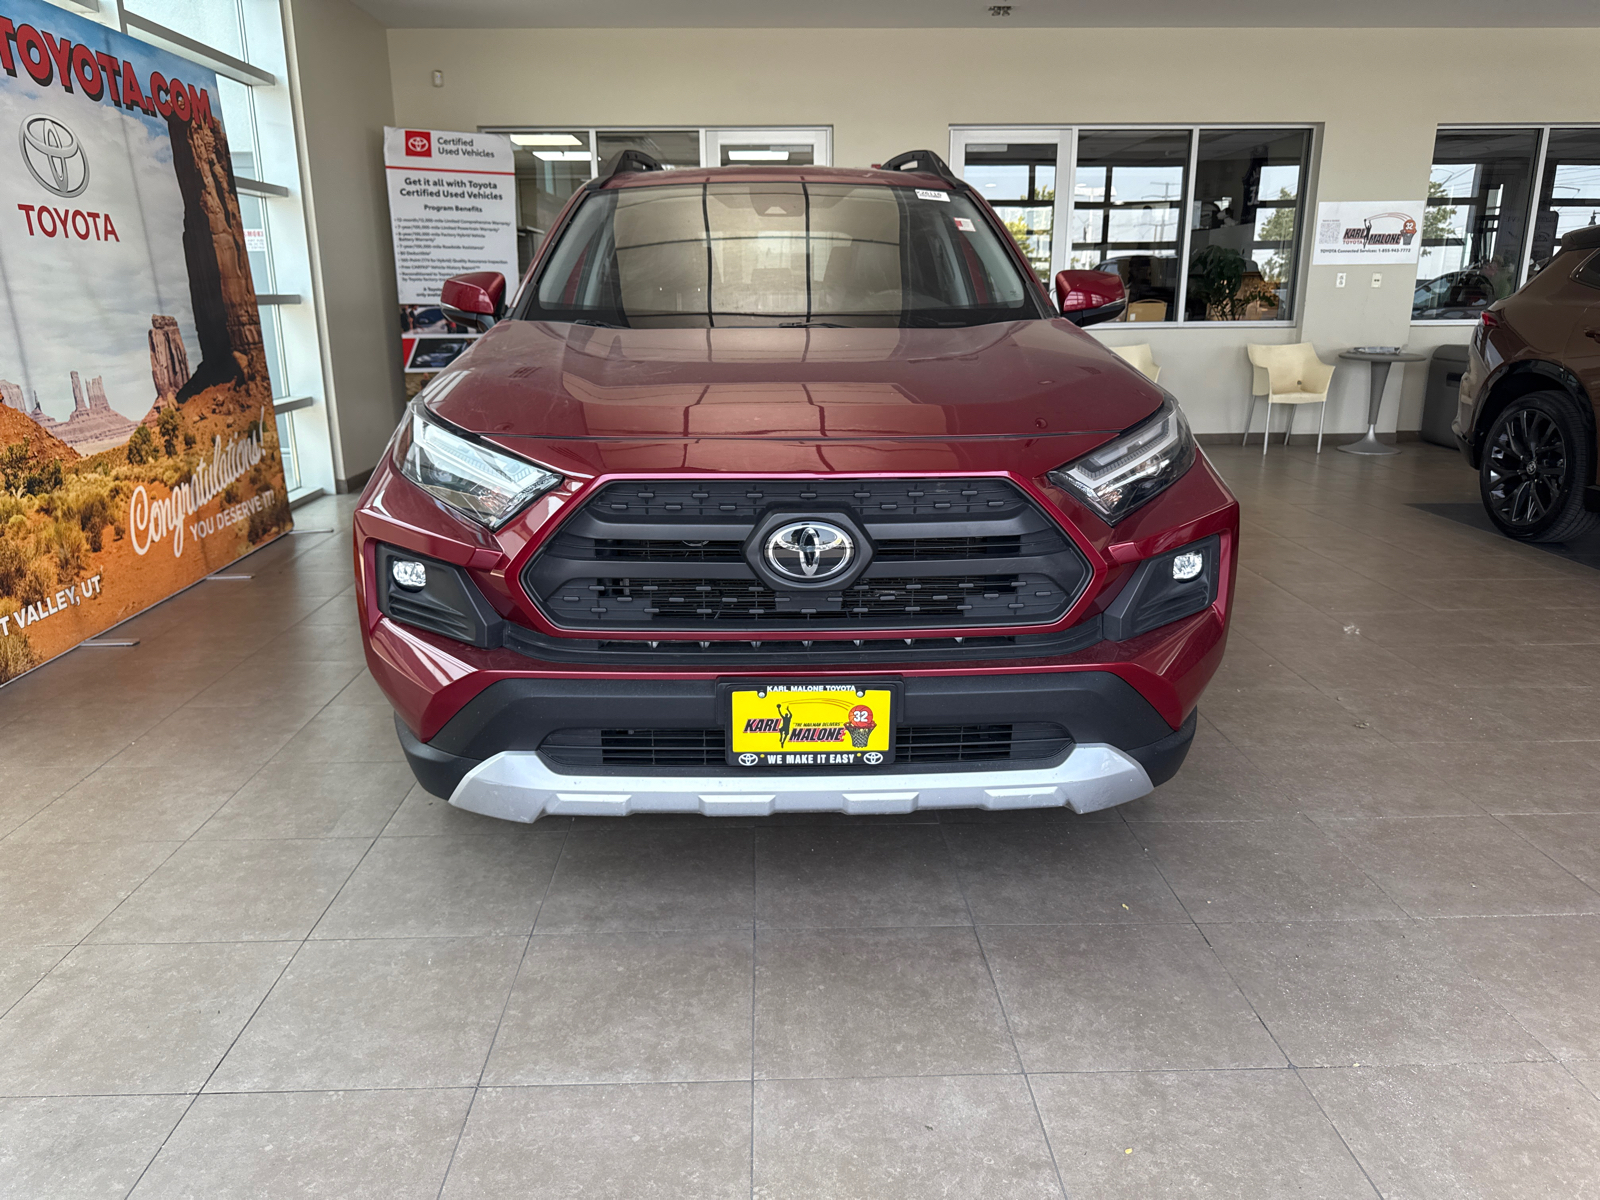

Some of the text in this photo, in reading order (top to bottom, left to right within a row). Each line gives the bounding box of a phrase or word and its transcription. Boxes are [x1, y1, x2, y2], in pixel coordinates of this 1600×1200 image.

[437, 137, 473, 147] Certified
[461, 148, 495, 158] Vehicles
[404, 178, 497, 190] Get it all with Toyota
[400, 188, 503, 200] Certified Used Vehicles
[424, 204, 454, 212] Program
[18, 204, 120, 242] TOYOTA
[1343, 228, 1402, 245] KARL MALONE
[130, 406, 266, 558] Congratulations!
[190, 490, 276, 541] YOU DESERVE IT!
[13, 586, 80, 629] VALLEY,
[81, 575, 102, 600] UT
[853, 711, 868, 722] 32
[743, 718, 846, 742] KARL MALONE
[767, 754, 855, 764] WE MAKE IT EASY
